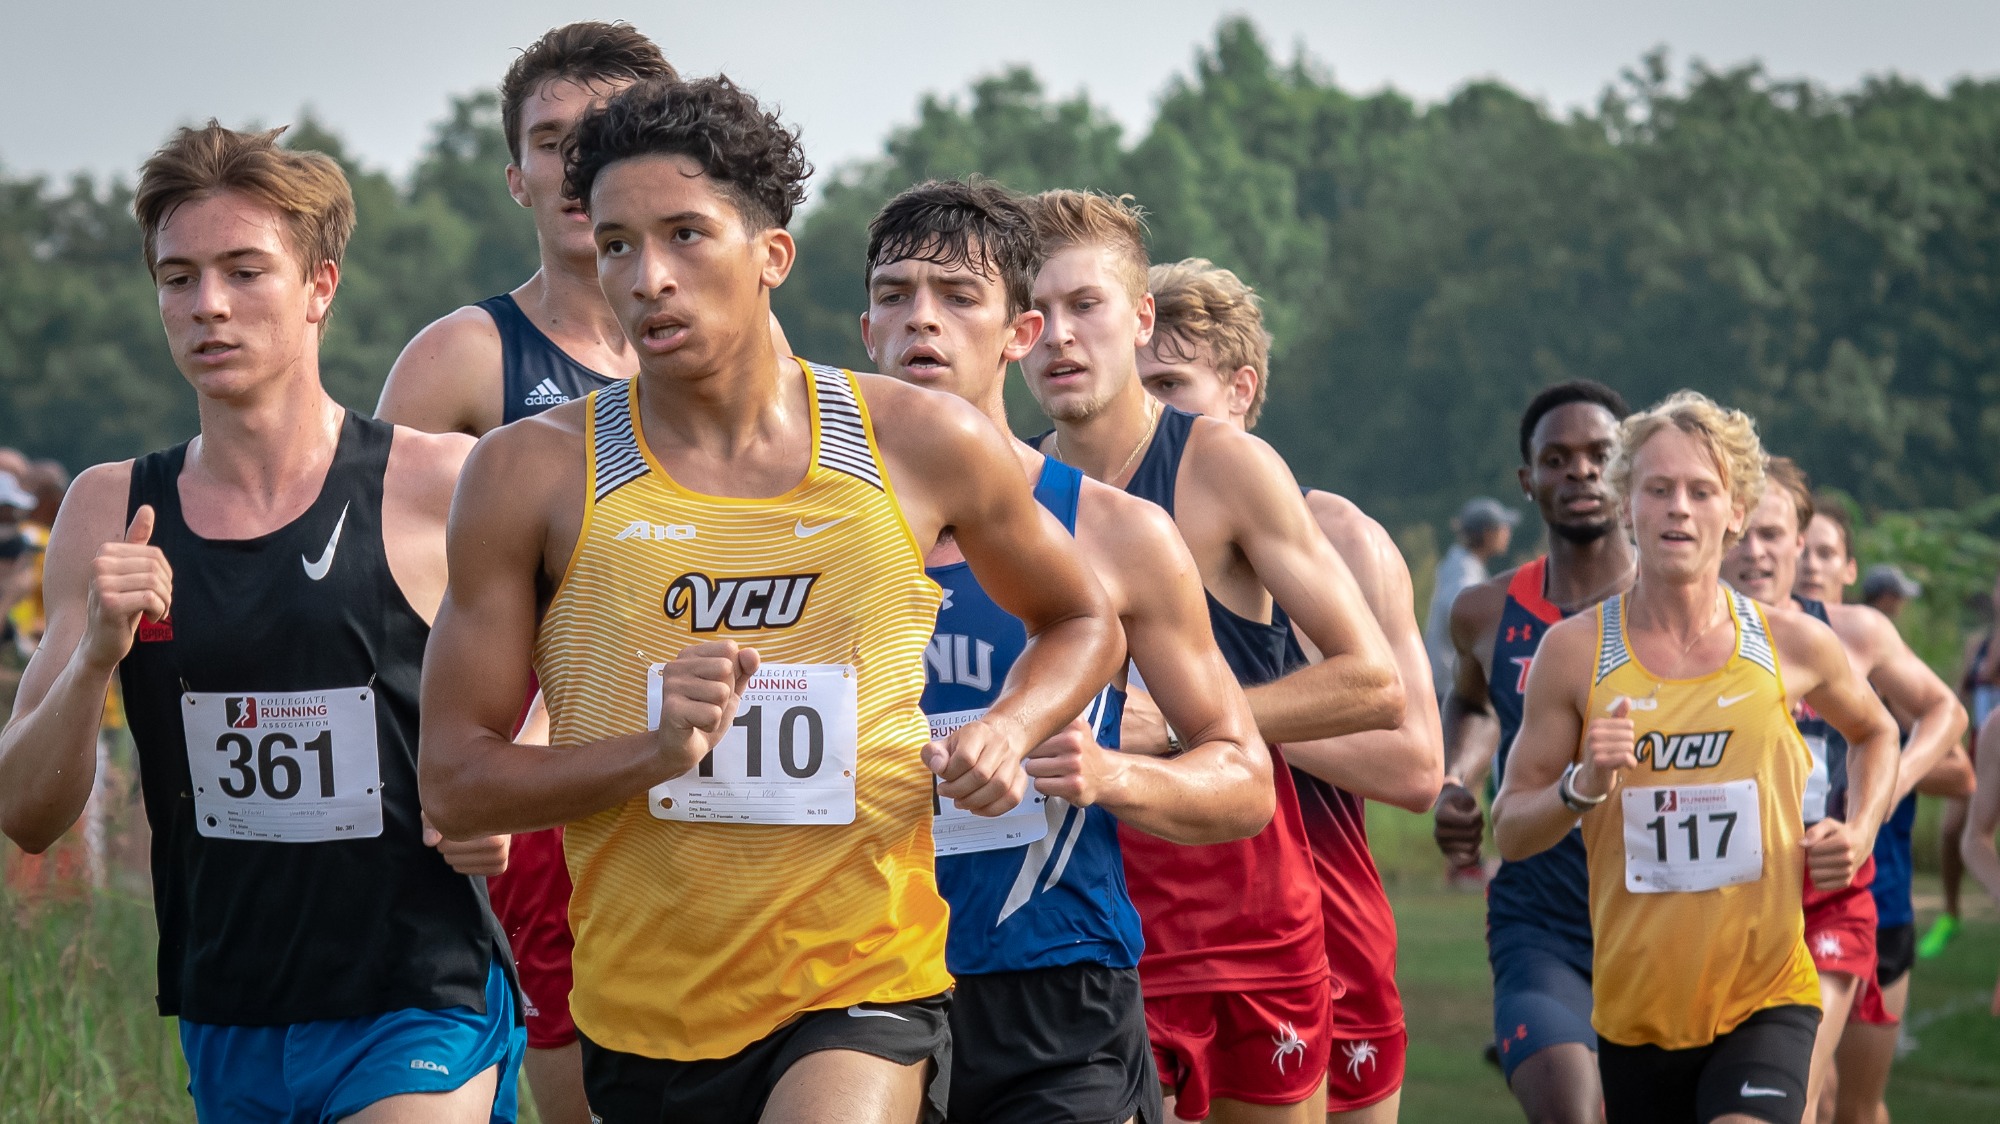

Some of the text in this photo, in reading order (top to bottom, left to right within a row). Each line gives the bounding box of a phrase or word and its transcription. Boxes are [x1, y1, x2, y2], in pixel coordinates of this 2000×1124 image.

[524, 394, 570, 406] adidas
[663, 572, 822, 633] VCU
[924, 633, 994, 692] NU
[753, 669, 808, 678] LEGIATE
[747, 678, 808, 690] UNNING
[260, 695, 327, 706] COLLEGIATE
[740, 694, 808, 702] SSOCIATION
[260, 704, 327, 718] RUNNING
[262, 719, 329, 729] ASSOCIATION
[930, 713, 984, 727] COLLEGIAT
[1634, 730, 1734, 772] VCU
[215, 730, 336, 801] 361
[1646, 812, 1738, 862] 117
[410, 1059, 449, 1075] BOA
